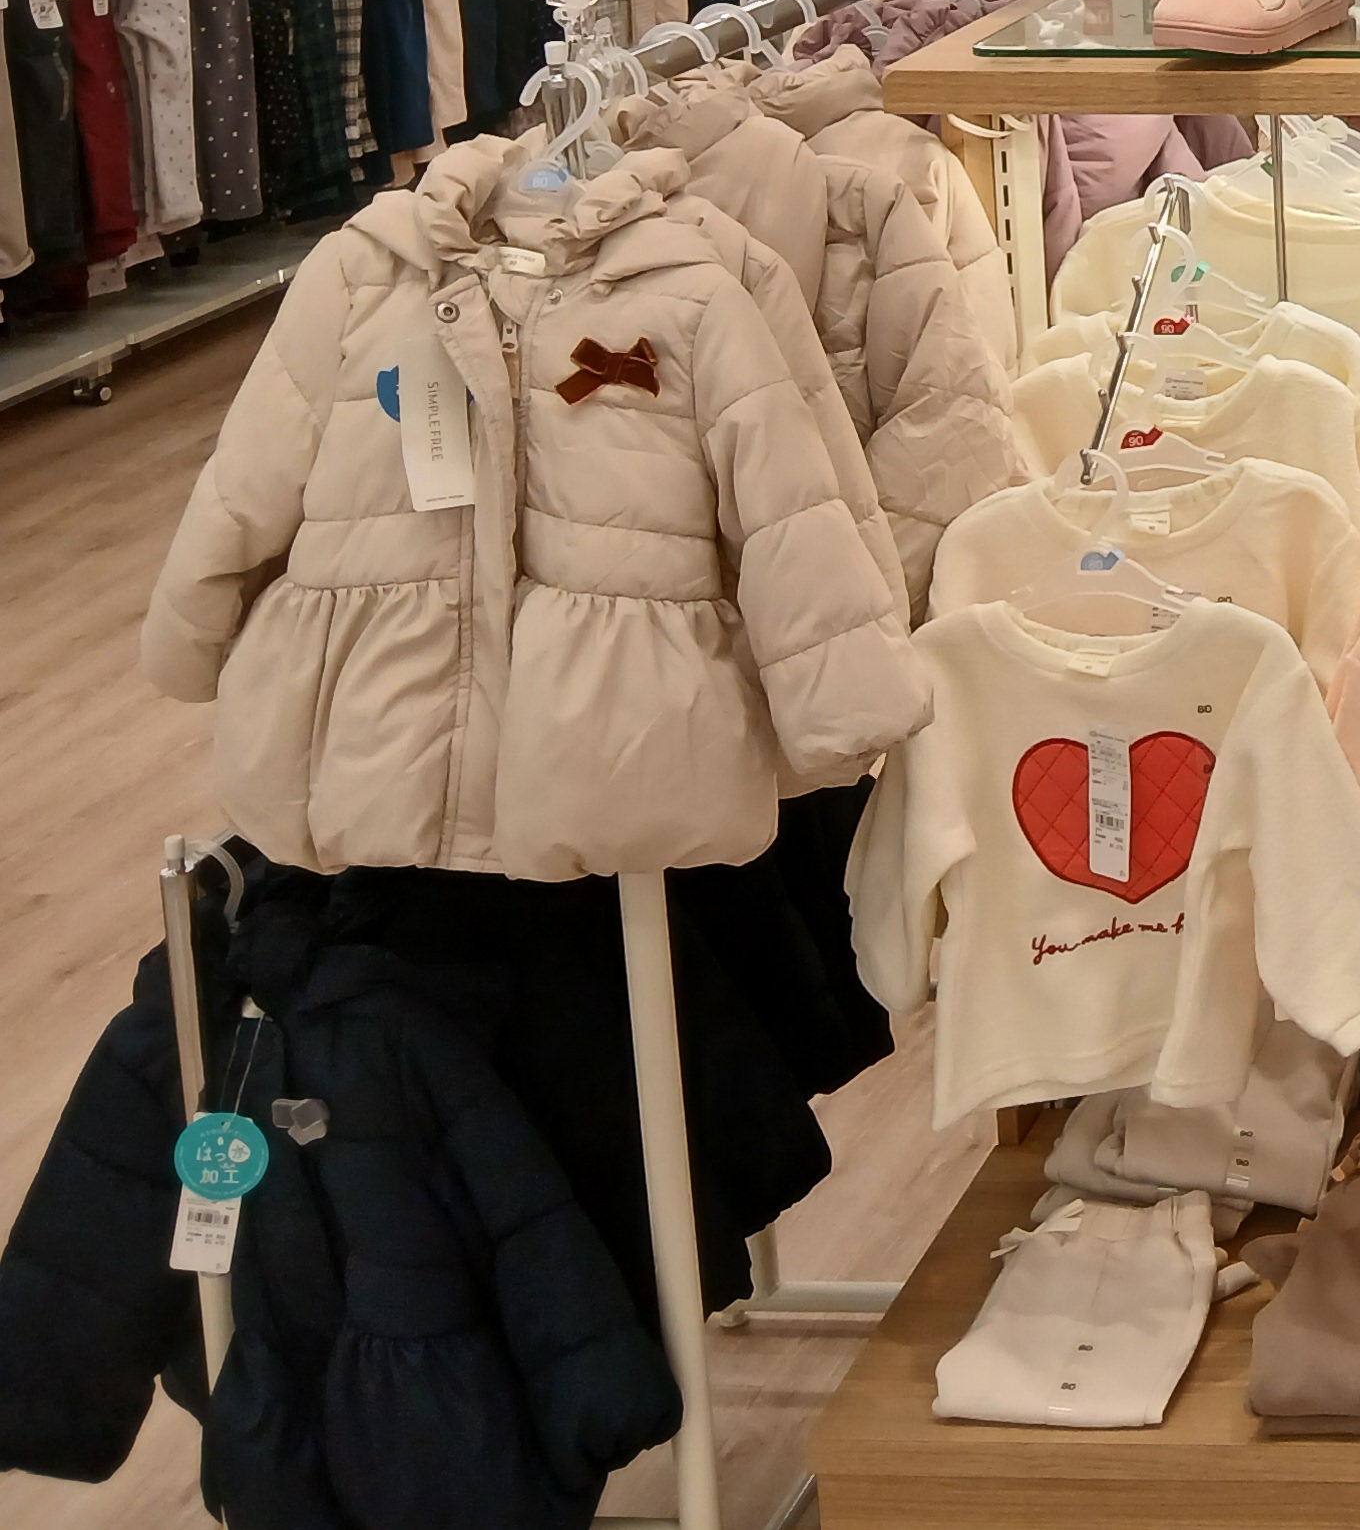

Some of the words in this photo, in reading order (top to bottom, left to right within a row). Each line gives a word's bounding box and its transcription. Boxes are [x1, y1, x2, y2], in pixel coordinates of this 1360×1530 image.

[1160, 324, 1174, 334] 90
[427, 381, 440, 428] SIMPLE
[430, 430, 443, 462] FREE
[1129, 436, 1143, 447] 90
[1197, 704, 1212, 713] 80
[1032, 934, 1080, 965] You
[1082, 916, 1134, 944] make
[1138, 923, 1168, 933] me
[199, 1167, 240, 1184] 加工
